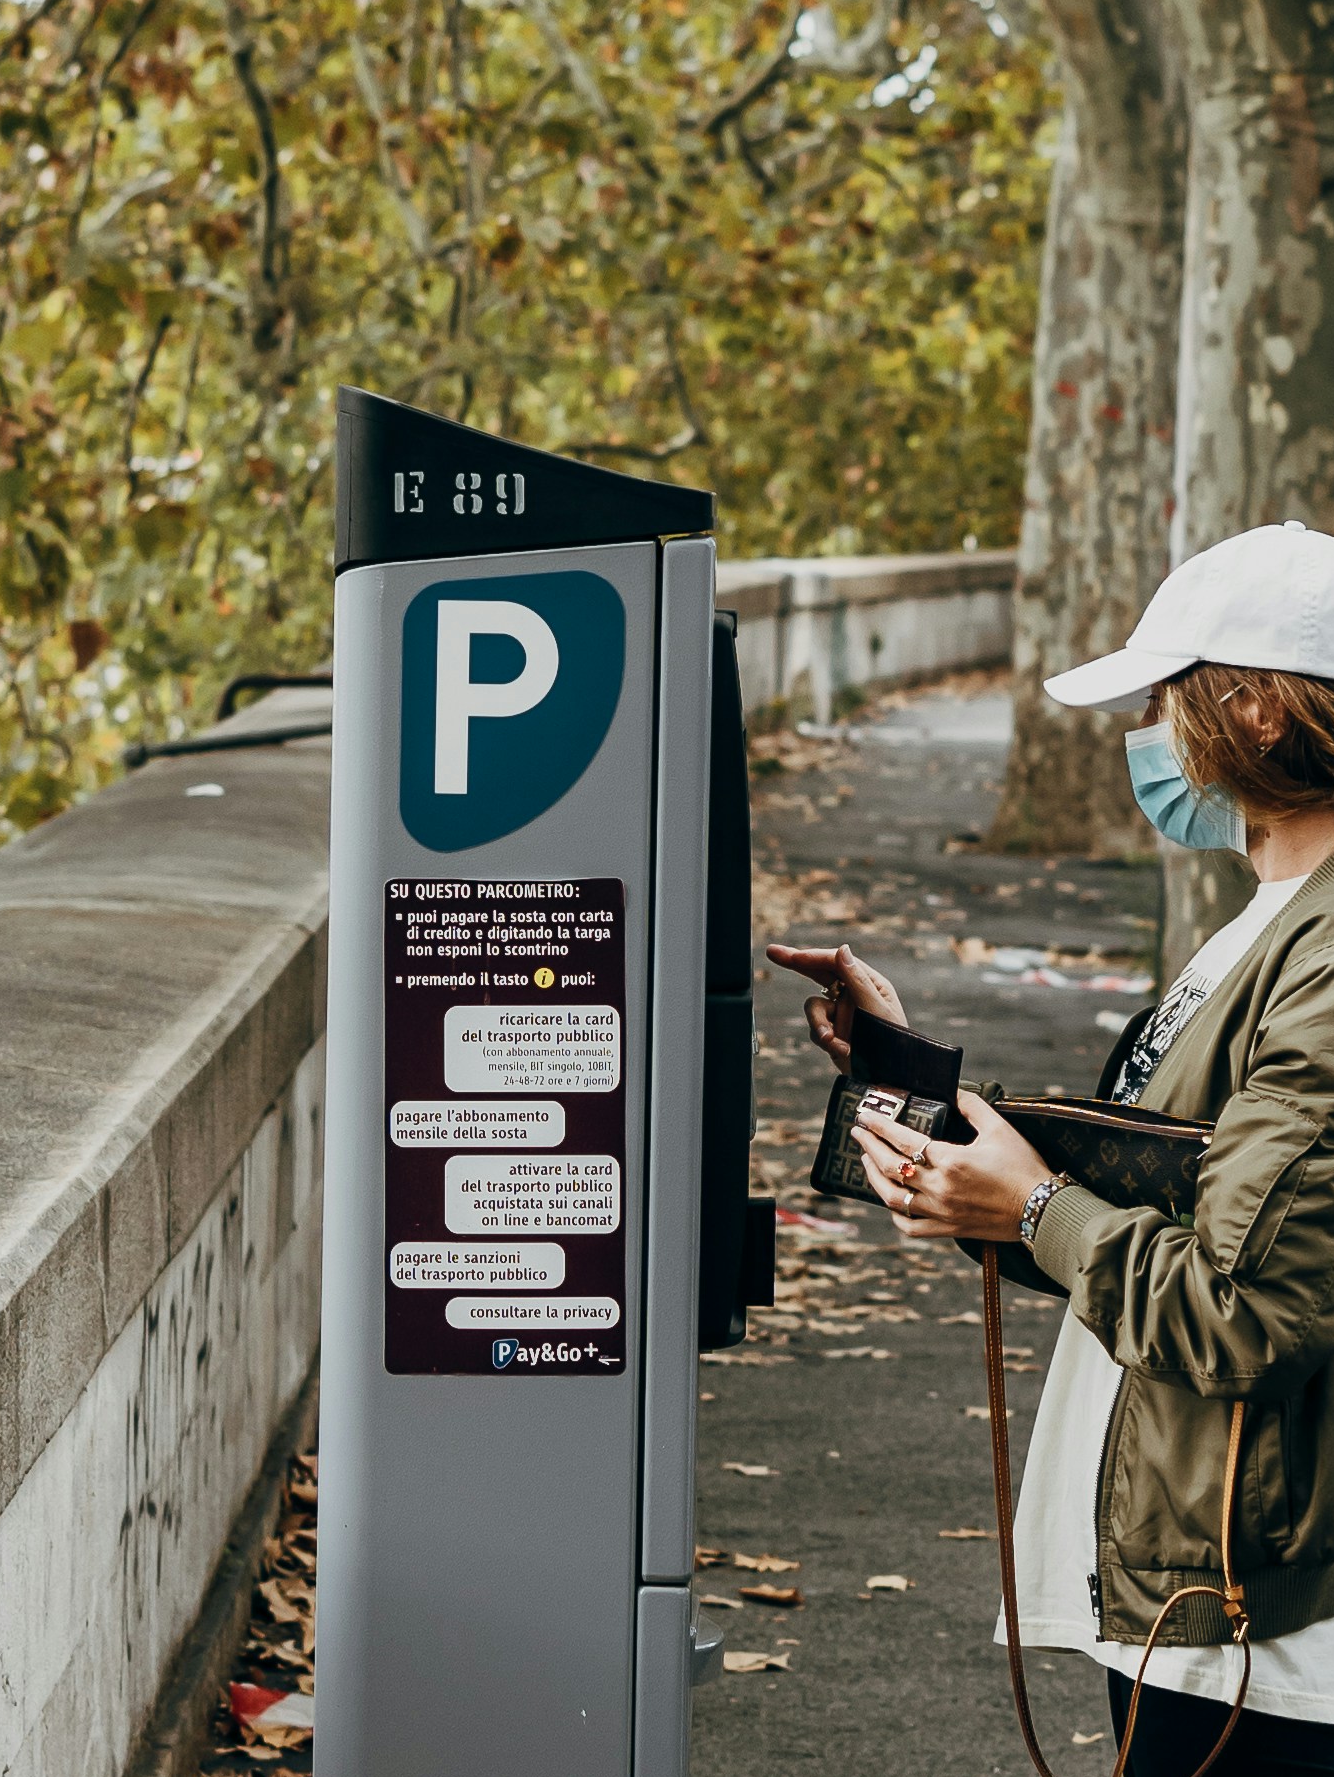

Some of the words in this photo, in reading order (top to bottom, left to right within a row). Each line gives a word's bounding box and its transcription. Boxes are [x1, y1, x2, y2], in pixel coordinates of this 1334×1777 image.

[393, 470, 425, 514] E
[452, 472, 526, 515] 89
[434, 599, 560, 795] P
[390, 883, 409, 899] SU
[414, 883, 471, 901] QUESTO
[477, 883, 580, 899] PARCOMETRO:
[407, 909, 437, 928] puoi
[441, 912, 489, 928] pagare
[492, 909, 506, 924] la
[509, 910, 547, 924] sosta
[550, 912, 575, 924] con
[579, 909, 614, 923] carta
[406, 925, 420, 940] di
[423, 925, 471, 940] credito
[475, 928, 484, 940] e
[487, 925, 553, 944] digitando
[557, 925, 571, 940] la
[574, 926, 611, 942] targa
[406, 945, 433, 957] non
[437, 942, 482, 960] esponi
[486, 942, 500, 956] lo
[504, 942, 569, 956] scontrino
[407, 971, 476, 989] premendo
[480, 971, 490, 986] il
[492, 973, 529, 986] tasto
[561, 971, 596, 989] puoi:
[499, 1012, 563, 1026] ricaricare
[567, 1011, 581, 1026] la
[585, 1011, 614, 1026] card
[461, 1029, 483, 1043] del
[487, 1030, 552, 1045] trasporto
[556, 1028, 614, 1045] pubblico
[482, 1045, 503, 1059] (con
[505, 1046, 571, 1057] abbonamento
[573, 1046, 614, 1058] annuale,
[488, 1061, 528, 1073] mensile,
[530, 1061, 544, 1071] BIT
[547, 1061, 585, 1074] singolo,
[587, 1061, 614, 1073] 10BIT,
[503, 1075, 545, 1086] 24-48-72
[547, 1077, 563, 1086] ore
[566, 1077, 572, 1086] e
[574, 1075, 580, 1086] 7
[583, 1074, 614, 1088] giorni)
[396, 1112, 442, 1126] pagare
[396, 1125, 448, 1140] mensile
[452, 1125, 487, 1140] della
[491, 1127, 528, 1140] sosta
[508, 1162, 562, 1176] attivare
[566, 1162, 580, 1176] la
[584, 1162, 613, 1176] card
[461, 1179, 482, 1193] del
[486, 1180, 551, 1196] trasporto
[555, 1178, 613, 1196] pubblico
[473, 1196, 544, 1212] acquistata
[548, 1195, 568, 1210] sui
[572, 1195, 613, 1210] canali
[481, 1216, 499, 1227] on
[504, 1212, 529, 1227] line
[533, 1216, 542, 1227] e
[546, 1212, 613, 1227] bancomat
[396, 1253, 443, 1267] pagare
[447, 1250, 460, 1264] le
[463, 1250, 521, 1264] sanzioni
[396, 1266, 417, 1281] del
[421, 1268, 485, 1283] trasporto
[489, 1267, 548, 1284] pubblico
[470, 1305, 542, 1319] consultare
[546, 1305, 559, 1319] la
[563, 1304, 613, 1322] privacy
